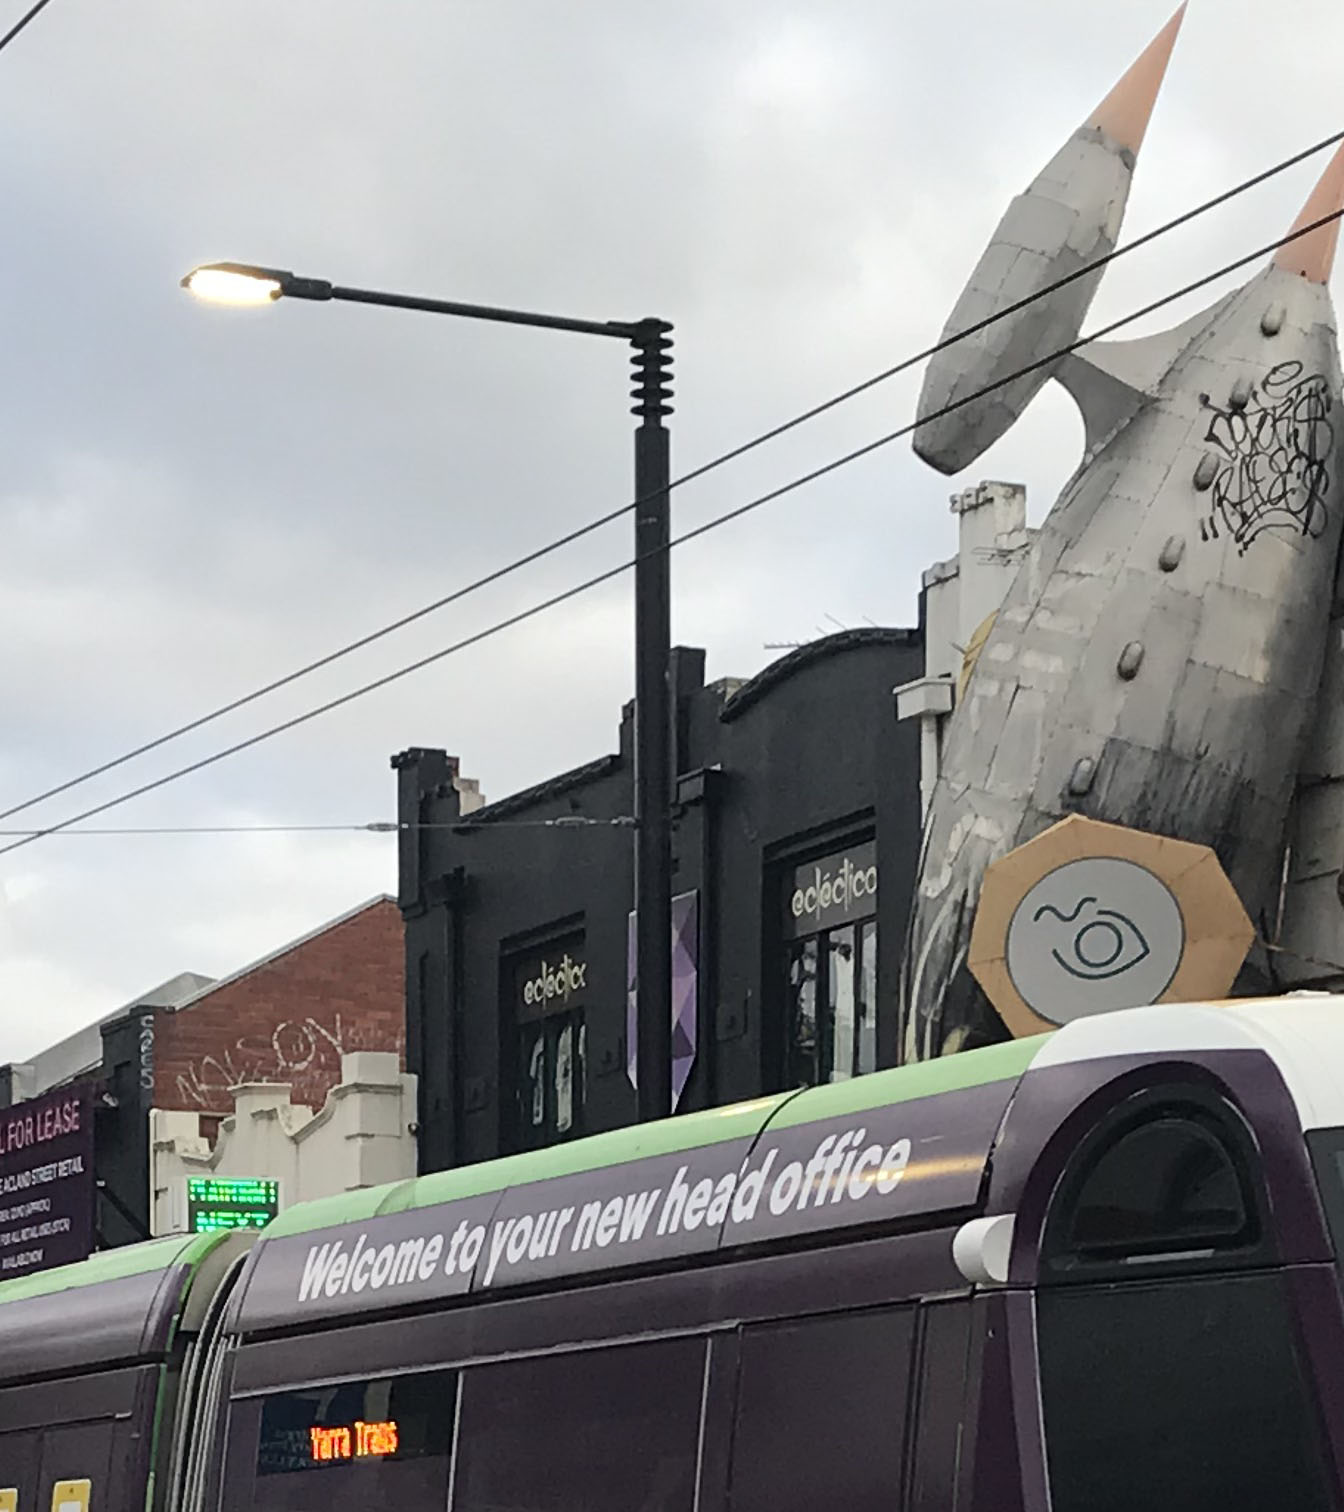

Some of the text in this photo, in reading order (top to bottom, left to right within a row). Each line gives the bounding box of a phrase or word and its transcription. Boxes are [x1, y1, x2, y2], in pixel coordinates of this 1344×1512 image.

[7, 1116, 35, 1151] FOR
[36, 1099, 81, 1142] LEASE
[297, 1127, 913, 1302] Welcome to your new head office
